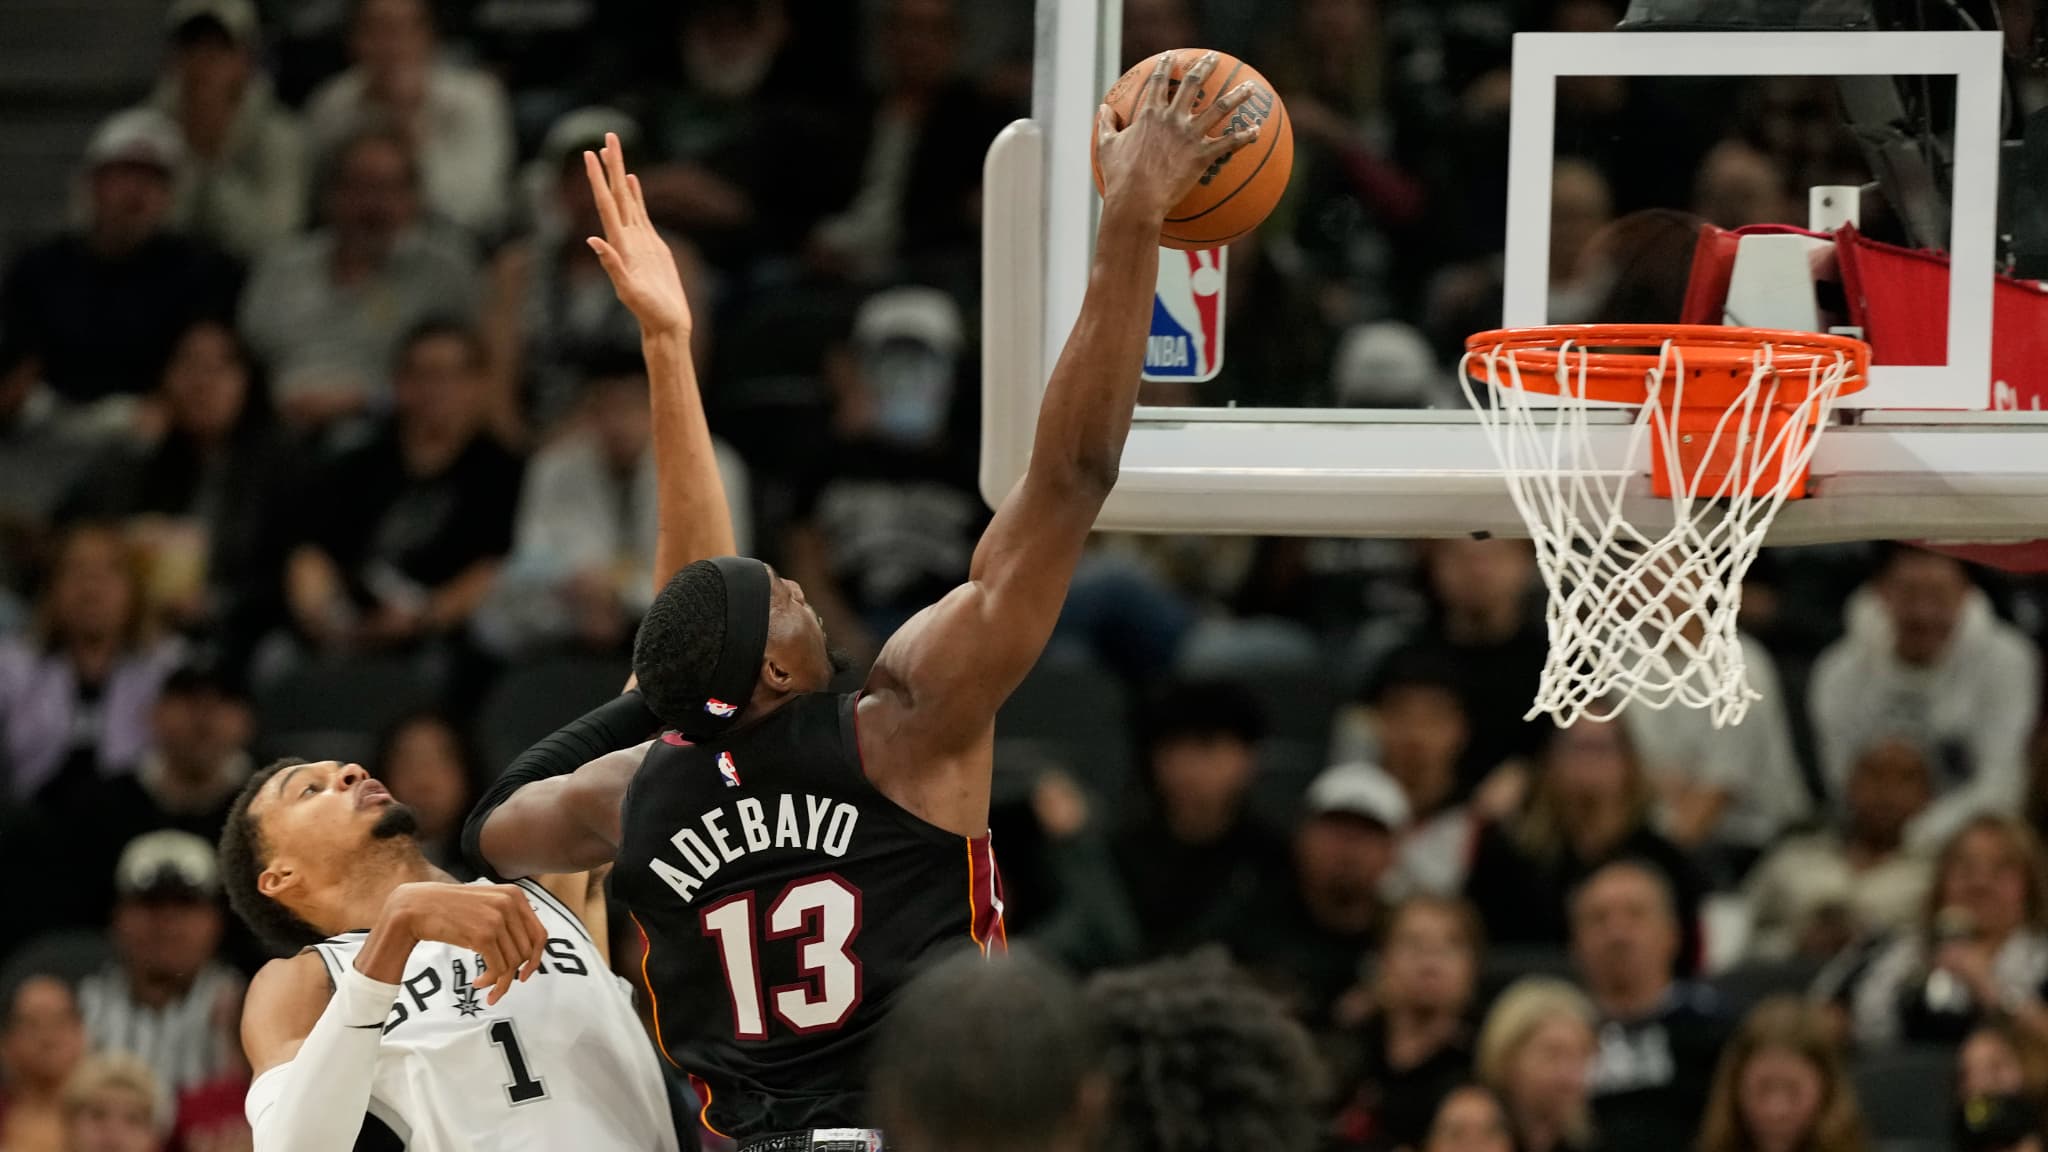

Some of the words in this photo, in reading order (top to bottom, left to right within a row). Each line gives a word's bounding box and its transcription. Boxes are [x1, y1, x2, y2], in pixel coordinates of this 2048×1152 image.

[1146, 335, 1188, 367] NBA
[649, 794, 859, 903] ADEBAYO
[700, 872, 862, 1040] 13
[487, 1018, 551, 1107] 1
